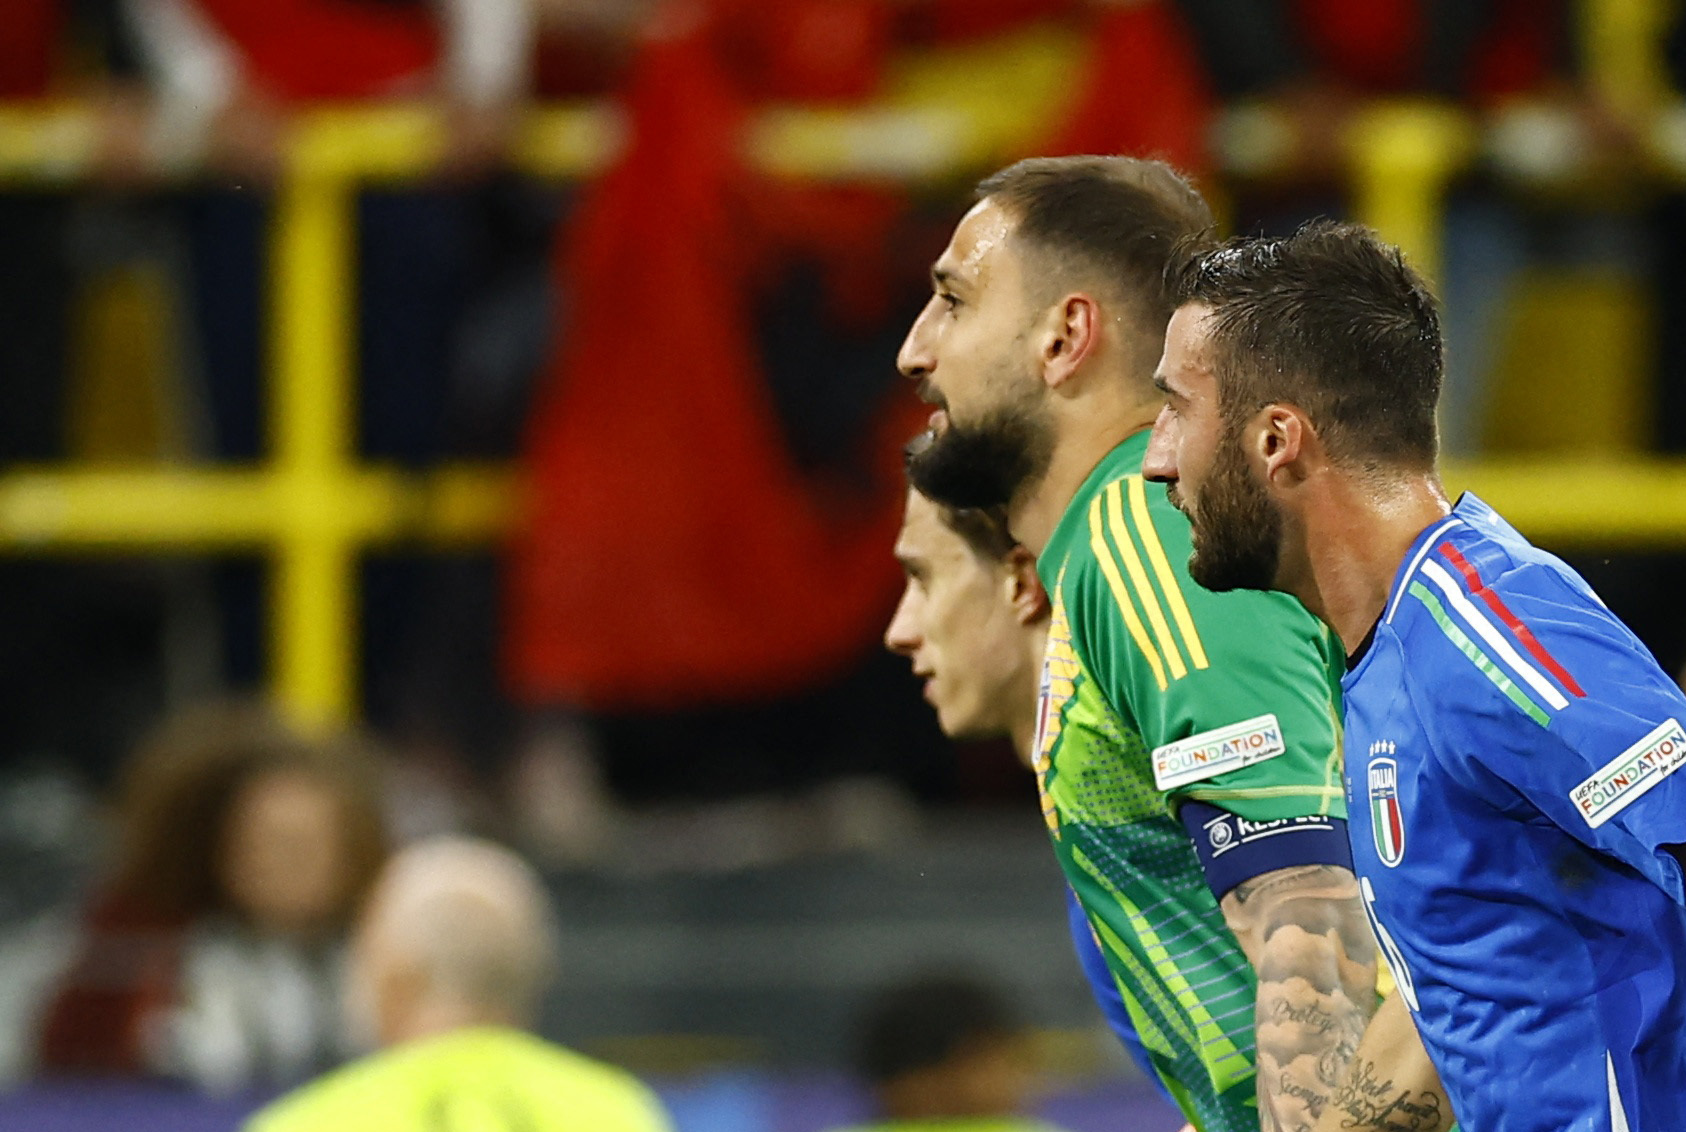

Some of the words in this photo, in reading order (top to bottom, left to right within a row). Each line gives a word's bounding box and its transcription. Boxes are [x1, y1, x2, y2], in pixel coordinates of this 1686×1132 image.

[1158, 729, 1278, 775] FOUNDATION
[1370, 768, 1395, 790] ITALIA
[1580, 731, 1686, 815] FOUNDATION
[1660, 763, 1669, 776] for
[1575, 779, 1600, 801] UEFA
